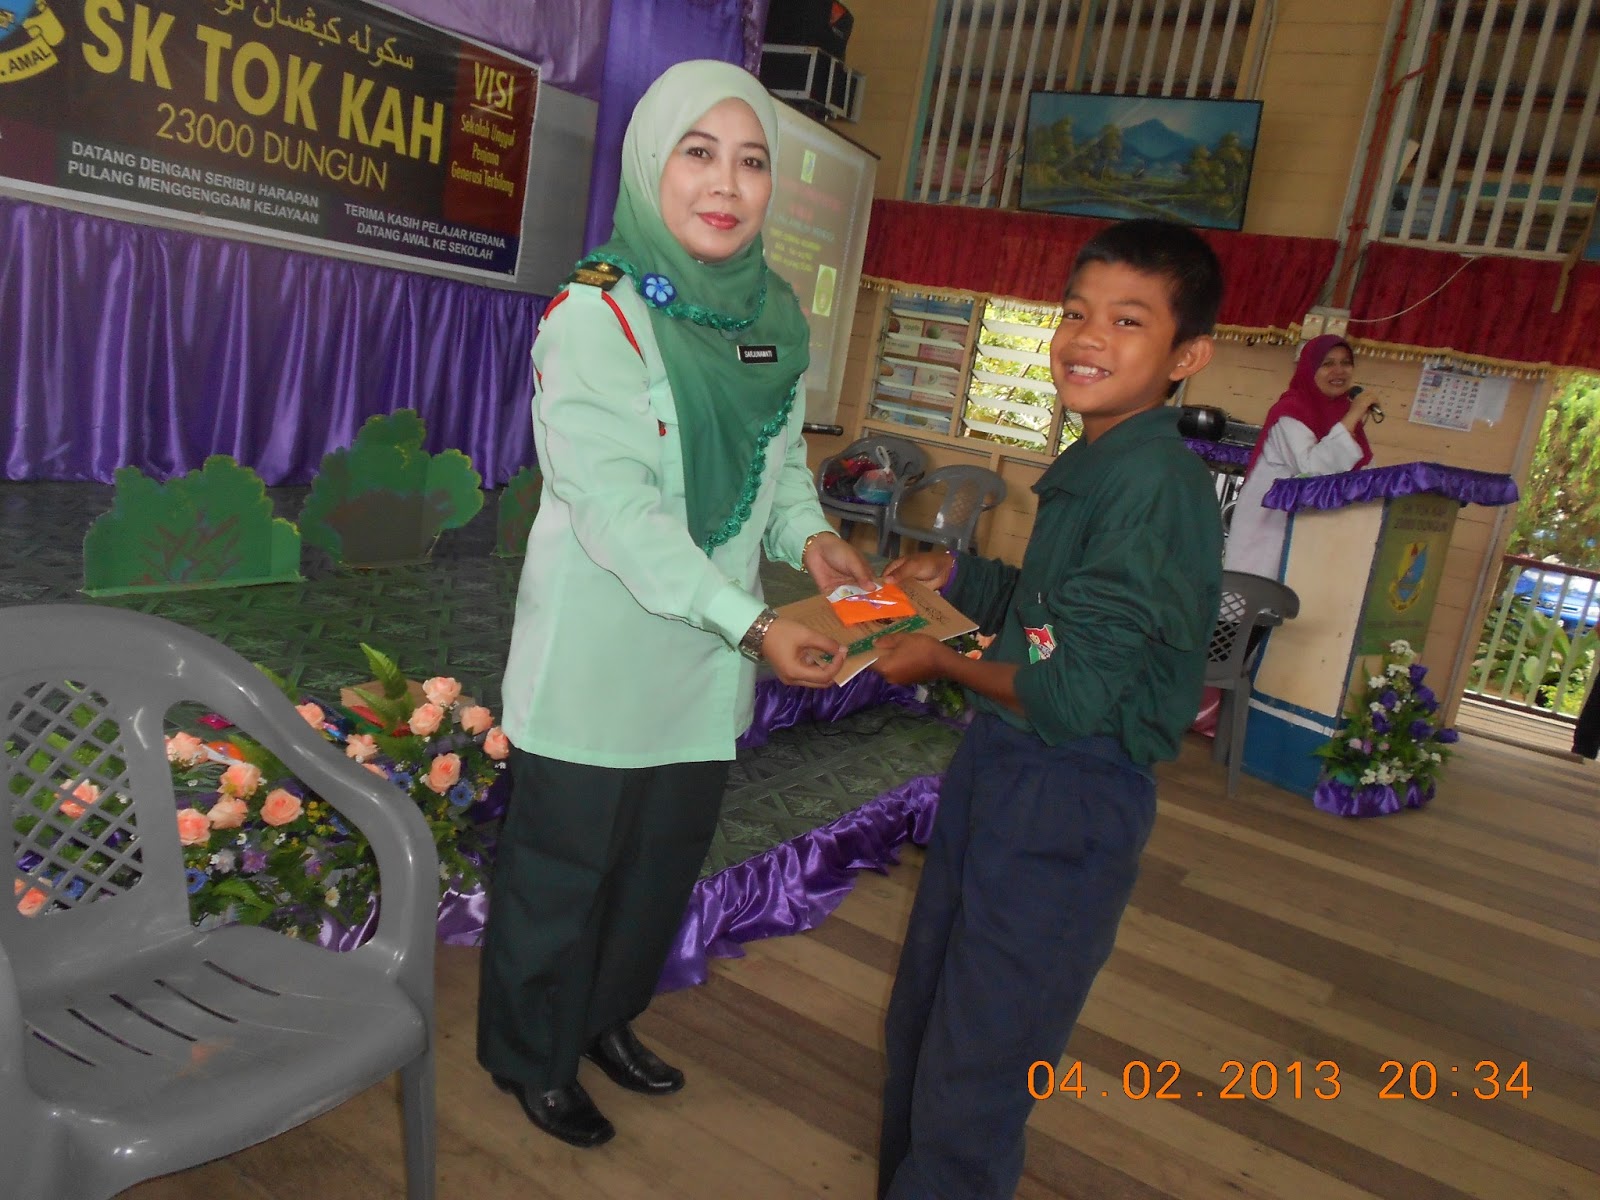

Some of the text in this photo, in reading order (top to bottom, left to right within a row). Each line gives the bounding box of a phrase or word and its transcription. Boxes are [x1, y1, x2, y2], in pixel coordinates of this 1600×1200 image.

[9, 46, 51, 74] AMAL
[82, 0, 444, 164] SK TOK KAH
[474, 61, 515, 111] VISI
[72, 141, 319, 208] DATANG DENGAN SERIBU HARAPAN
[156, 103, 388, 191] 23000 DUNGUN
[68, 160, 319, 225] PULANG MENGGENGGAM KEJAYAAN
[344, 203, 506, 248] TERIMA KASIH PELAJAR KERANA
[357, 222, 494, 260] DATANG AWAL KE SEKOLAH
